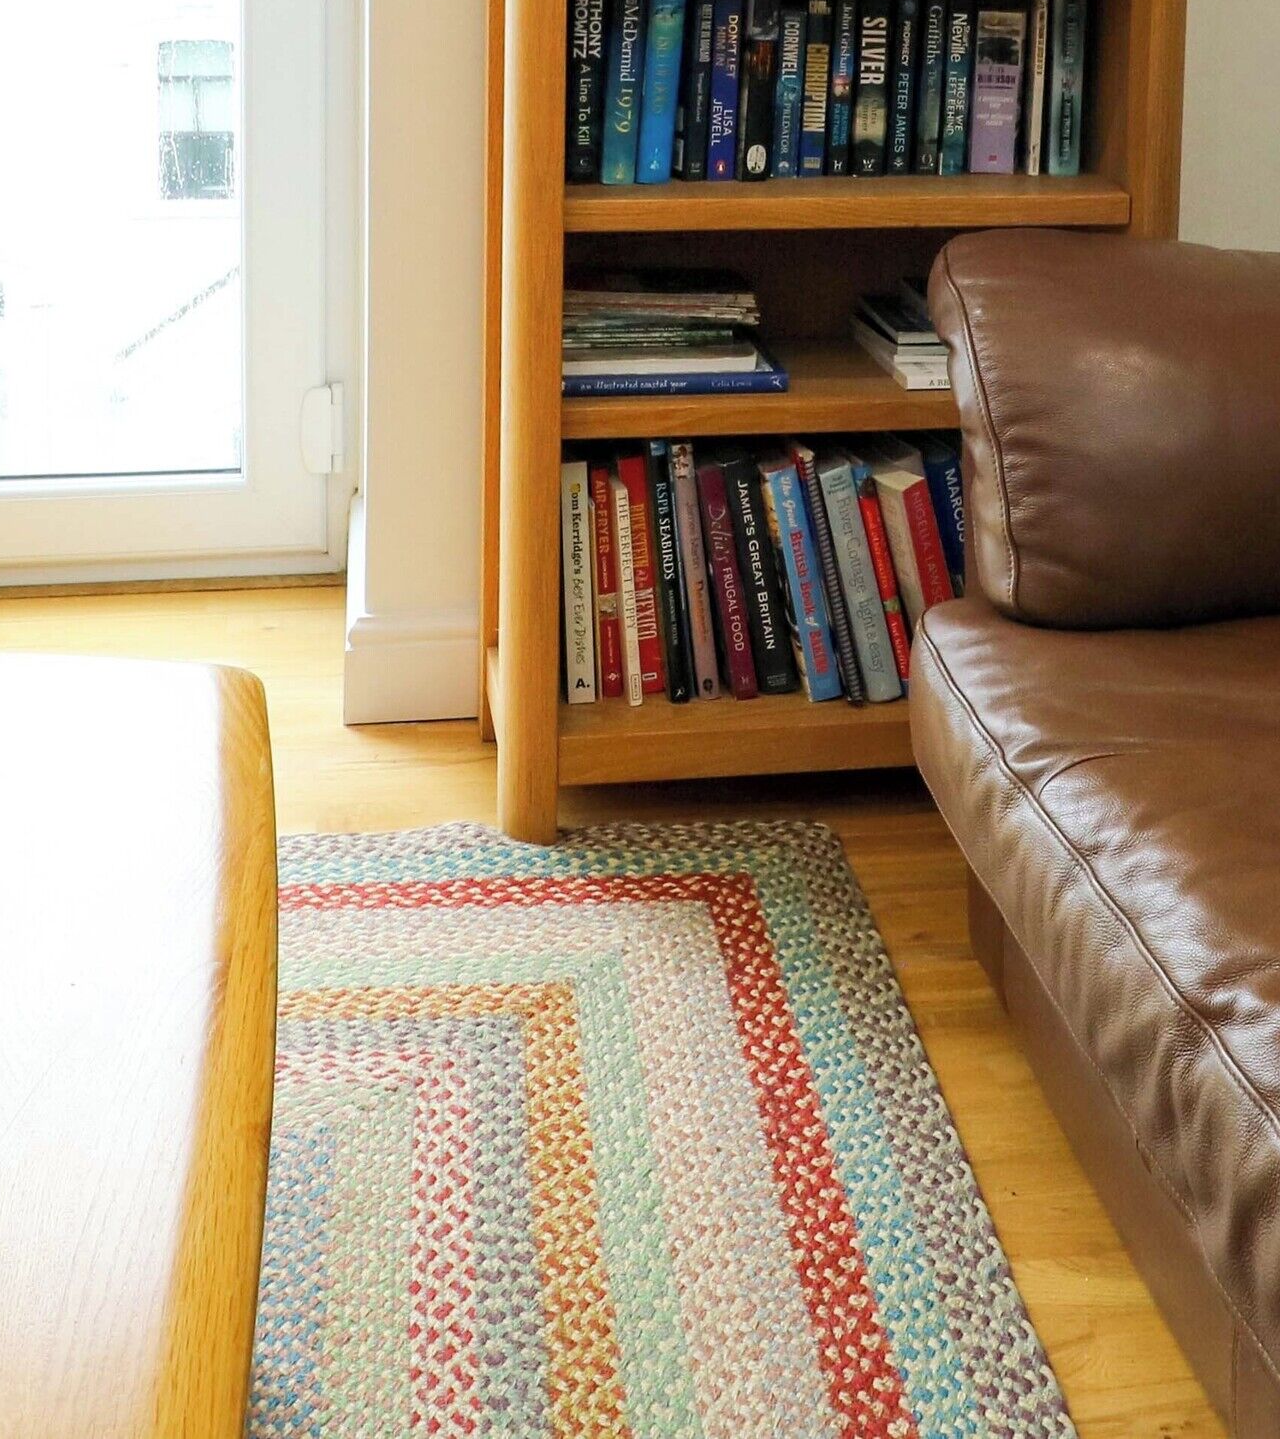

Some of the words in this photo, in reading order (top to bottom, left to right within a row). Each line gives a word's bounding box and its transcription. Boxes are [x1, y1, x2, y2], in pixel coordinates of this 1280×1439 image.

[728, 15, 739, 54] DON'T
[842, 3, 853, 30] John
[927, 5, 944, 64] Griffiths
[620, 5, 641, 82] McDermid
[781, 21, 800, 81] CORNWELL
[839, 32, 852, 76] Grisham
[860, 17, 888, 85] SILVER
[901, 21, 911, 67] PROPHECY
[950, 13, 968, 62] Neville
[580, 64, 590, 74] A
[726, 57, 736, 80] LET
[802, 44, 830, 132] CORRUPTION
[947, 71, 957, 96] LEFT
[579, 78, 591, 102] Line
[897, 72, 910, 110] PETER
[956, 77, 966, 110] THOSE
[579, 106, 591, 122] To
[614, 87, 634, 133] 1979
[711, 98, 722, 146] JEWELL
[723, 109, 733, 137] LISA
[780, 101, 792, 154] PREDATOR
[839, 105, 849, 146] SPARRING
[945, 98, 956, 136] BEHIND
[955, 115, 965, 132] WE
[577, 125, 591, 146] Kill
[894, 114, 906, 153] JAMES
[594, 381, 638, 390] illustrated
[639, 379, 668, 389] coastal
[670, 380, 687, 393] year
[571, 483, 581, 510] Tom
[618, 496, 628, 518] THE
[656, 482, 669, 514] RSPB
[780, 476, 793, 499] The
[594, 480, 610, 553] AIR-FRYER
[782, 499, 799, 529] Great
[911, 490, 931, 551] NIGELLA
[570, 511, 582, 575] Kerridge's
[620, 520, 633, 583] PERFECT
[659, 518, 676, 579] SEABIRDS
[789, 530, 808, 578] British
[708, 503, 733, 563] Delia's
[722, 566, 738, 613] FRUGAL
[730, 615, 745, 652] FOOD
[737, 480, 756, 537] JAMIE'S
[748, 540, 766, 587] GREAT
[757, 592, 776, 650] BRITAIN
[836, 496, 853, 537] River
[846, 537, 867, 593] Cottage
[858, 597, 877, 630] light
[869, 634, 886, 673] easy
[573, 577, 584, 600] Best
[624, 587, 637, 629] PUPPY
[800, 579, 816, 616] Book
[574, 603, 585, 627] Ever
[635, 587, 657, 640] MEXICO
[574, 628, 587, 665] Dishes
